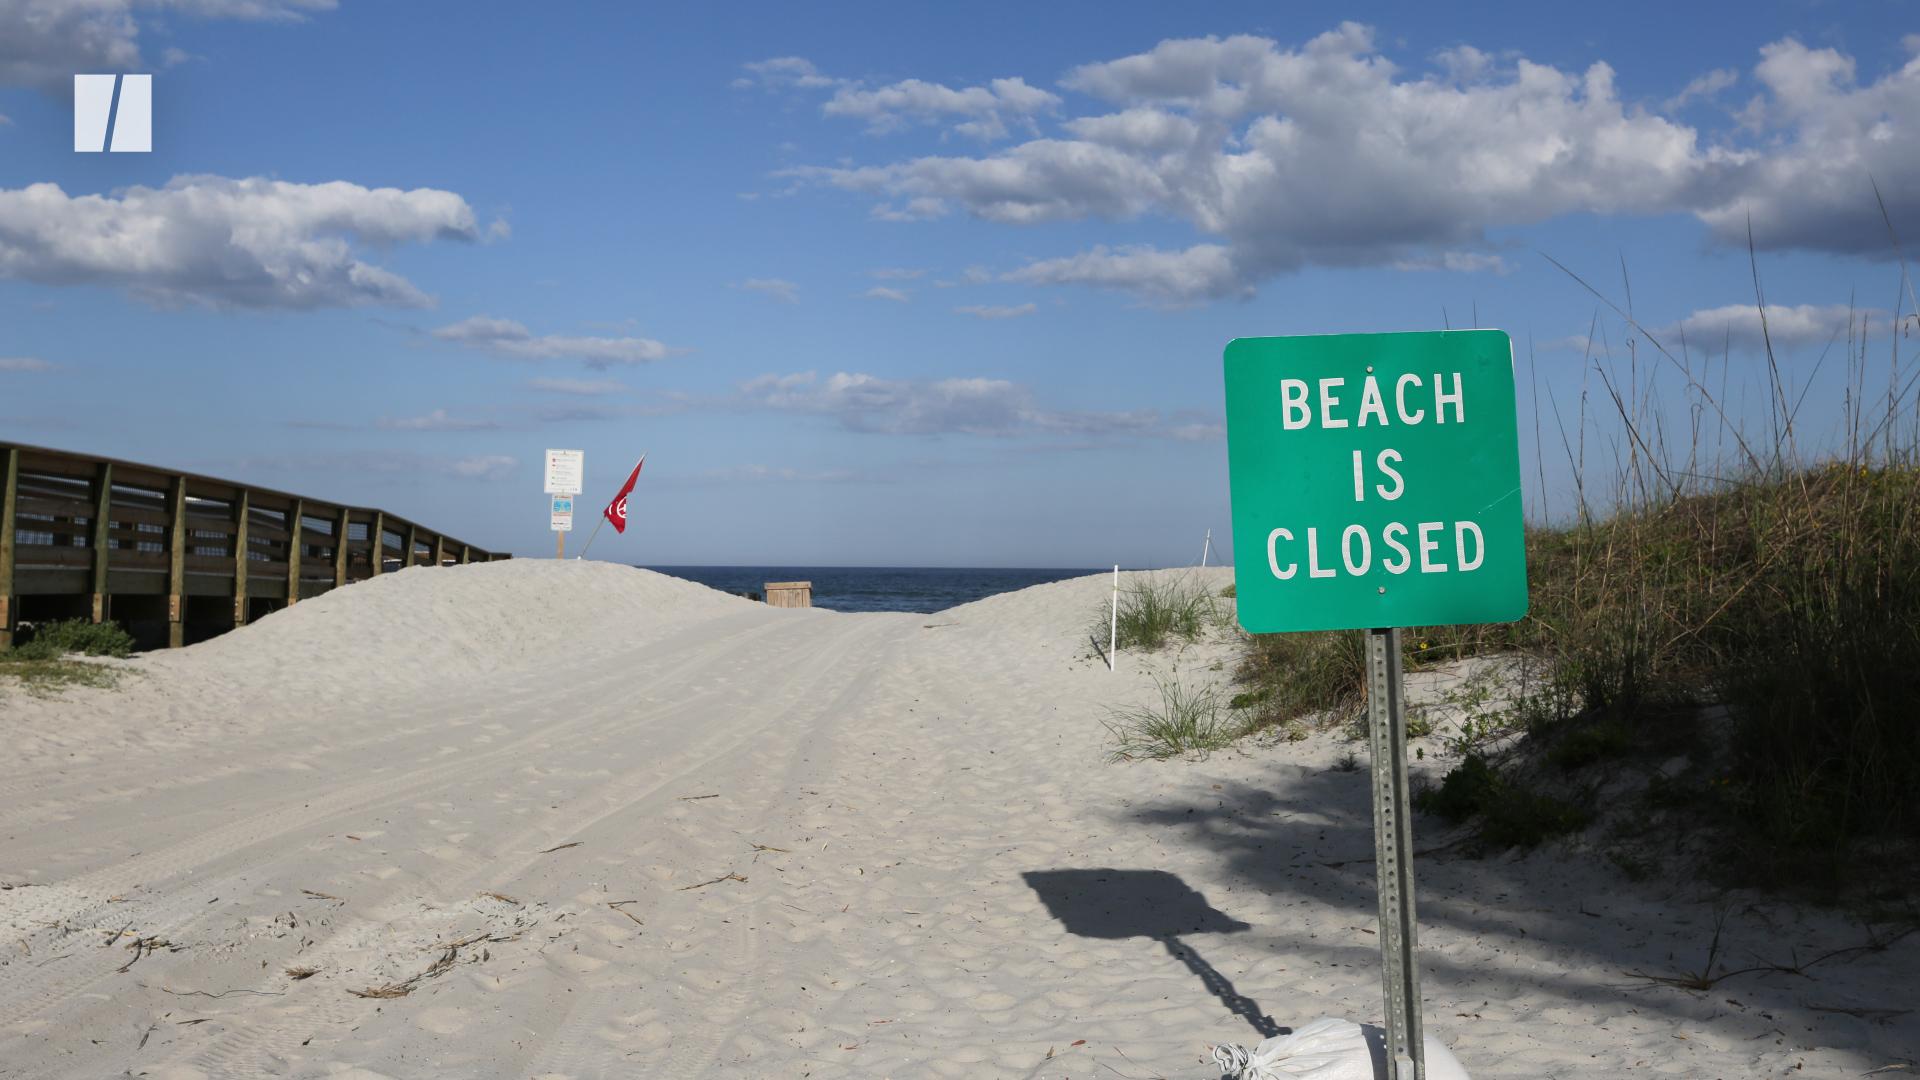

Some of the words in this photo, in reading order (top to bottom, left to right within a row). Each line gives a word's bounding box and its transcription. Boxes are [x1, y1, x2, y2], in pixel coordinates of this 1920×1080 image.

[1280, 372, 1465, 430] BEACH
[1352, 448, 1405, 502] IS
[1267, 520, 1485, 580] CLOSED
